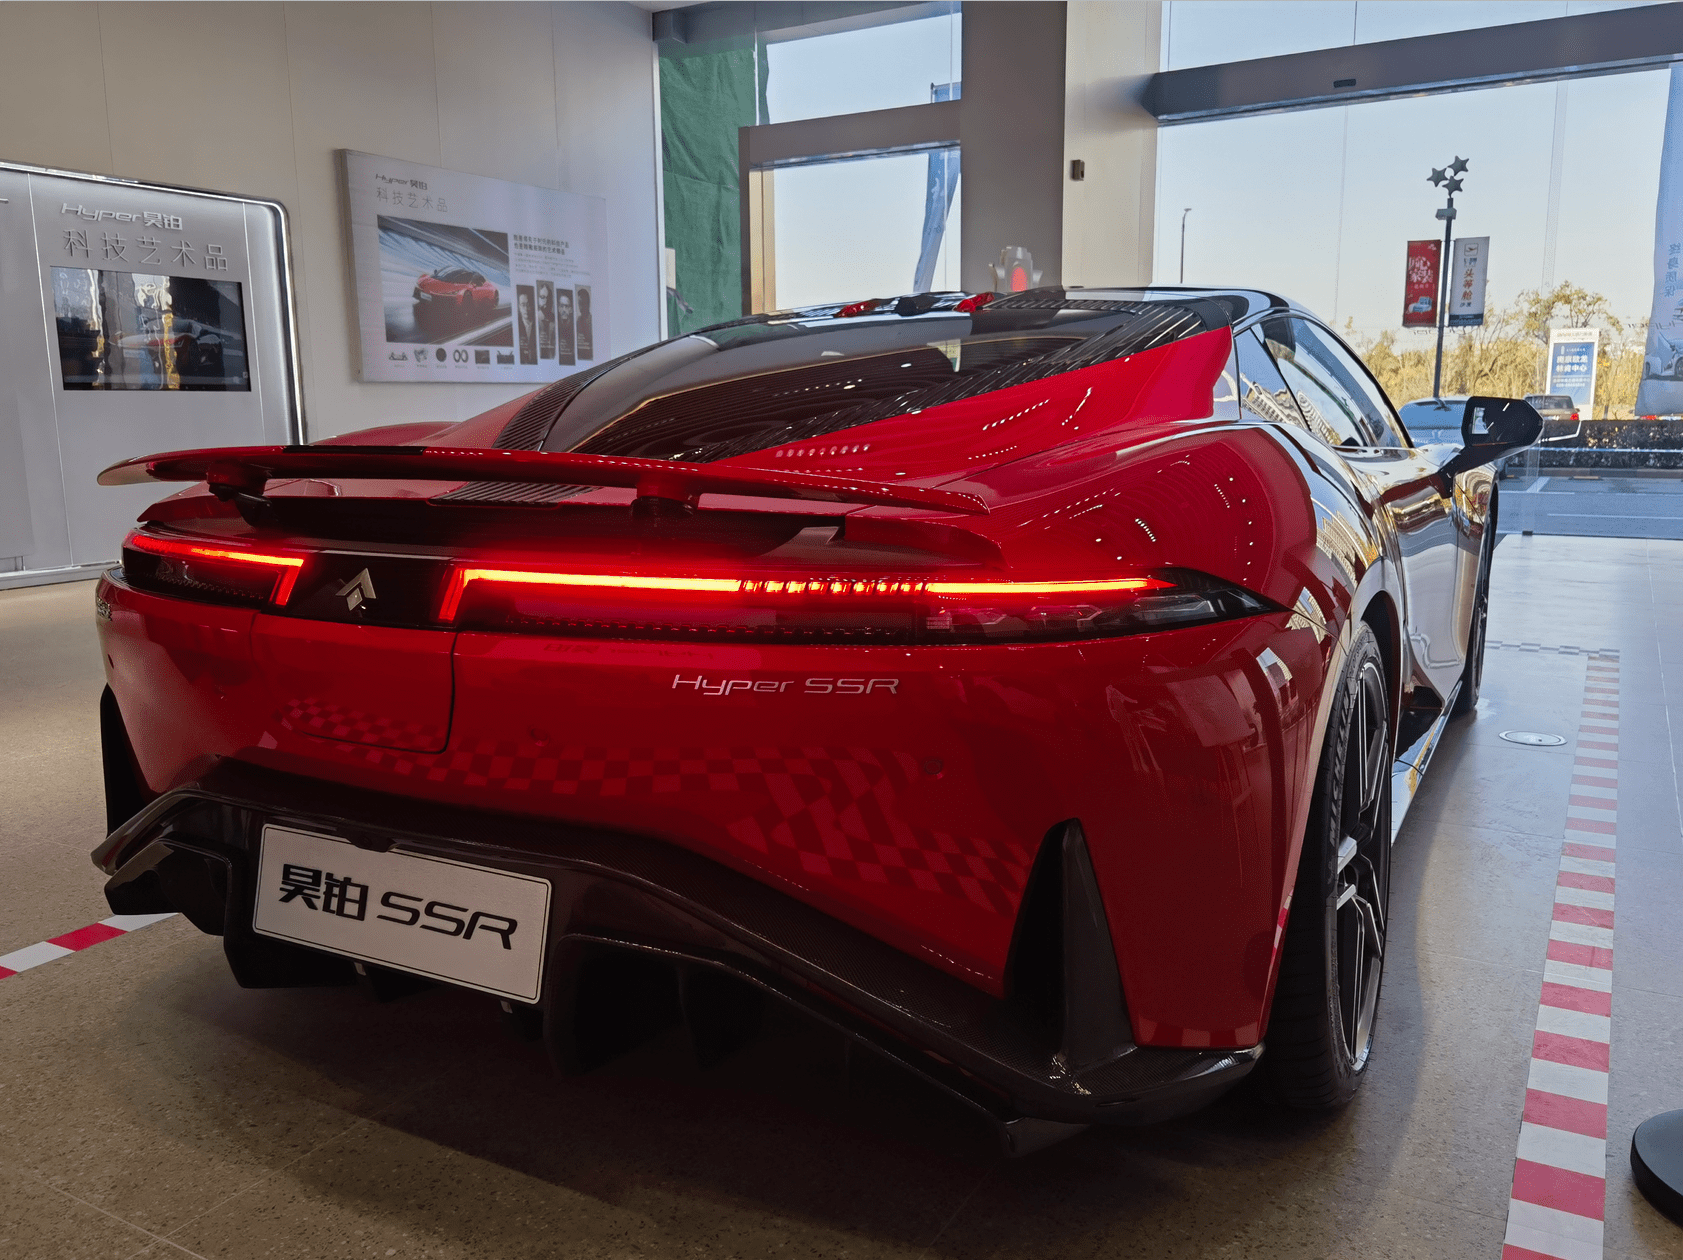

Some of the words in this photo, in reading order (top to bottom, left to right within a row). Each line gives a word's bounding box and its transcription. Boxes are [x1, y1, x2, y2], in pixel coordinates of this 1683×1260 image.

[376, 187, 448, 212] 科技艺术品
[63, 228, 228, 271] 科技艺术品
[1461, 268, 1476, 301] 头等舱
[672, 674, 794, 696] Hyper
[804, 677, 899, 695] SSR
[1328, 687, 1350, 847] MICHELIN
[279, 863, 369, 922] 昊铂
[376, 891, 518, 950] SSR
